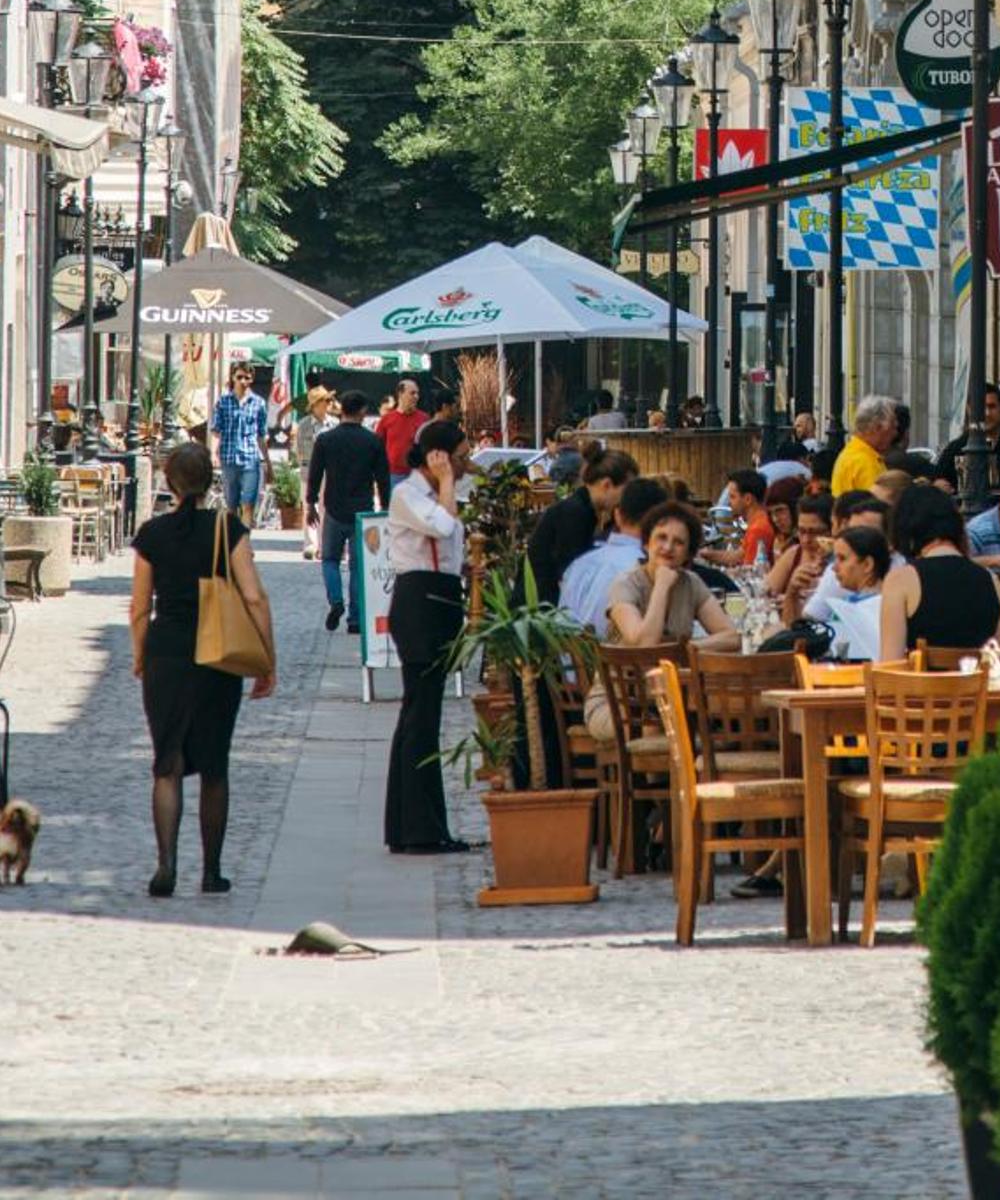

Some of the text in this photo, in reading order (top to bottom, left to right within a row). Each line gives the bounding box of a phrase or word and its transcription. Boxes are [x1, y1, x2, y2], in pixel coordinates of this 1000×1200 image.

[927, 69, 976, 86] TUBO
[139, 305, 270, 324] GUINNESS
[381, 301, 502, 333] Carlsberg
